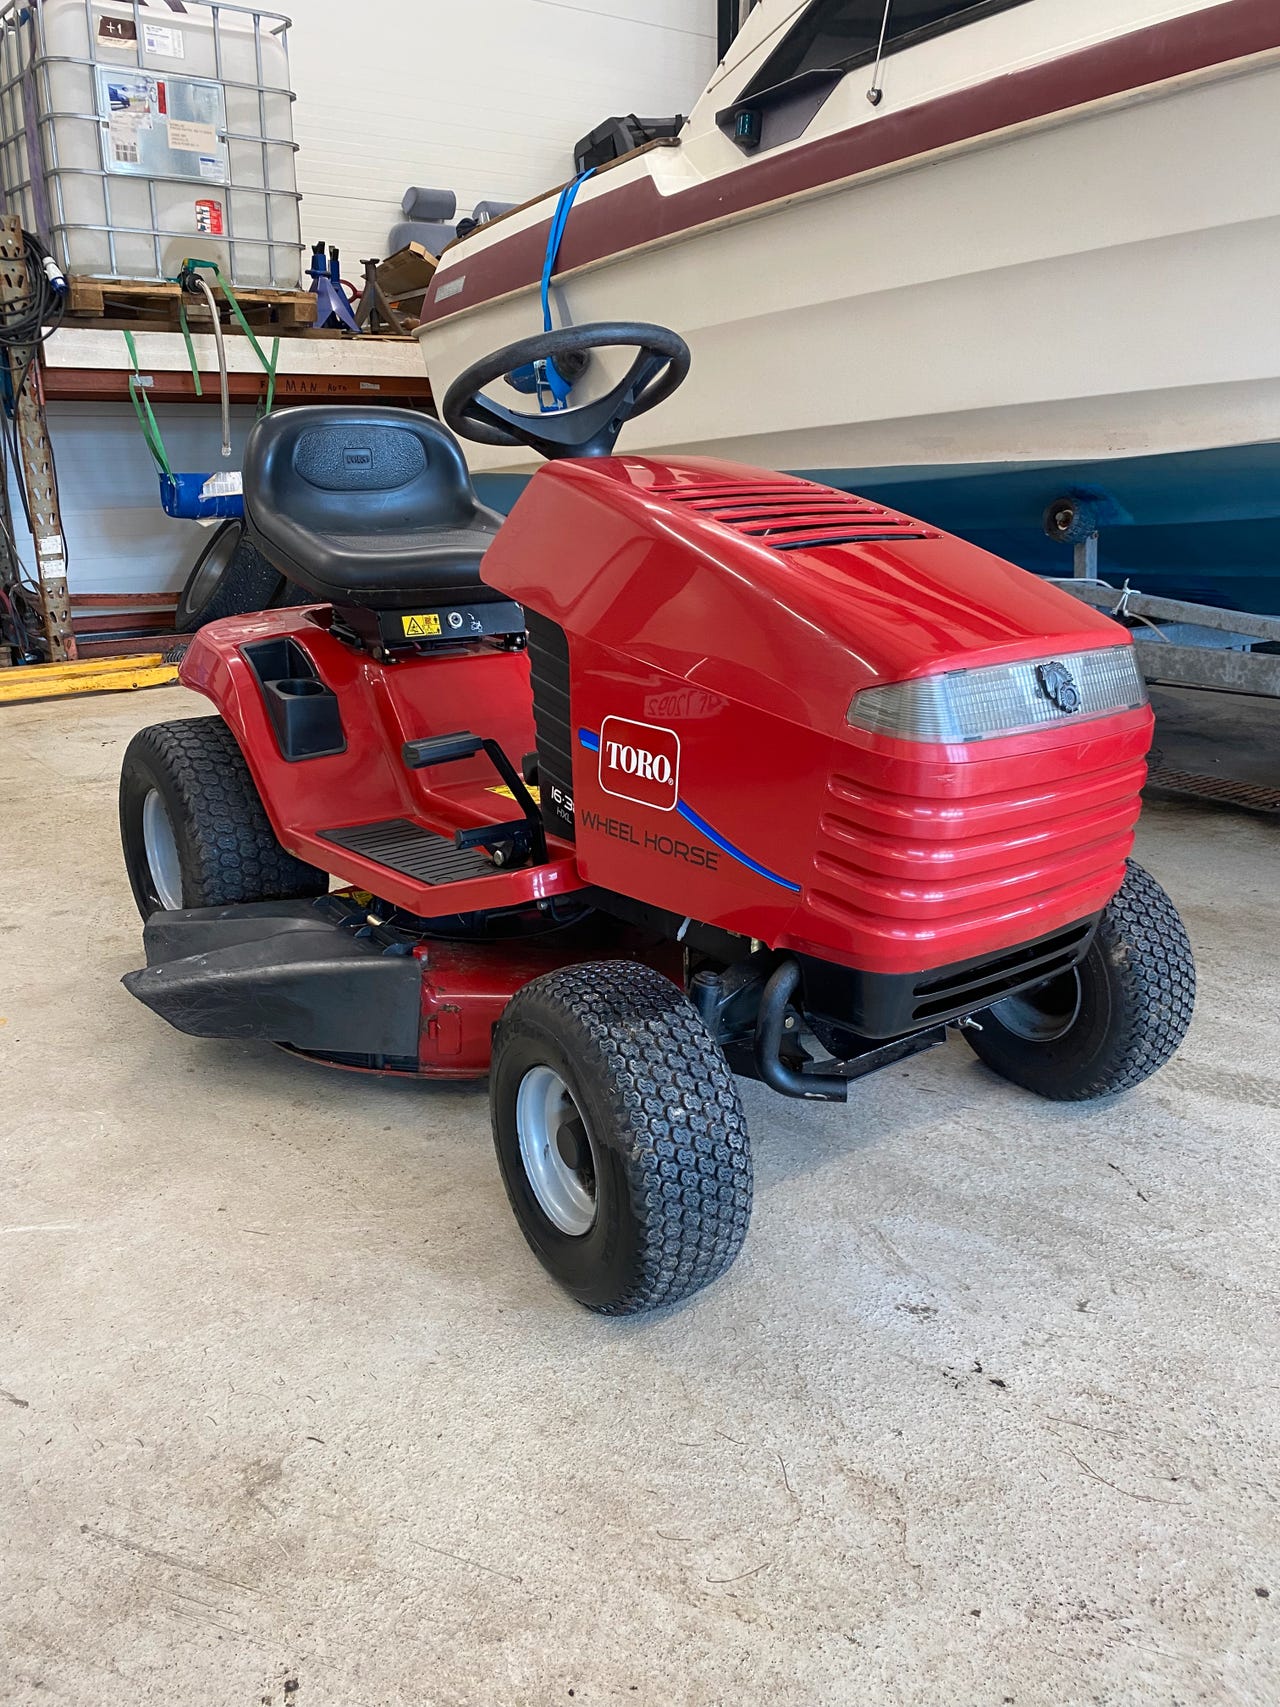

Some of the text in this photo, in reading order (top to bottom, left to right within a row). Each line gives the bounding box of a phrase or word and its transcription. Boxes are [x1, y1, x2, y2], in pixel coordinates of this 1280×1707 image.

[606, 740, 673, 785] TORO
[556, 806, 573, 825] HXL
[581, 809, 720, 871] WHEEL HORSE
